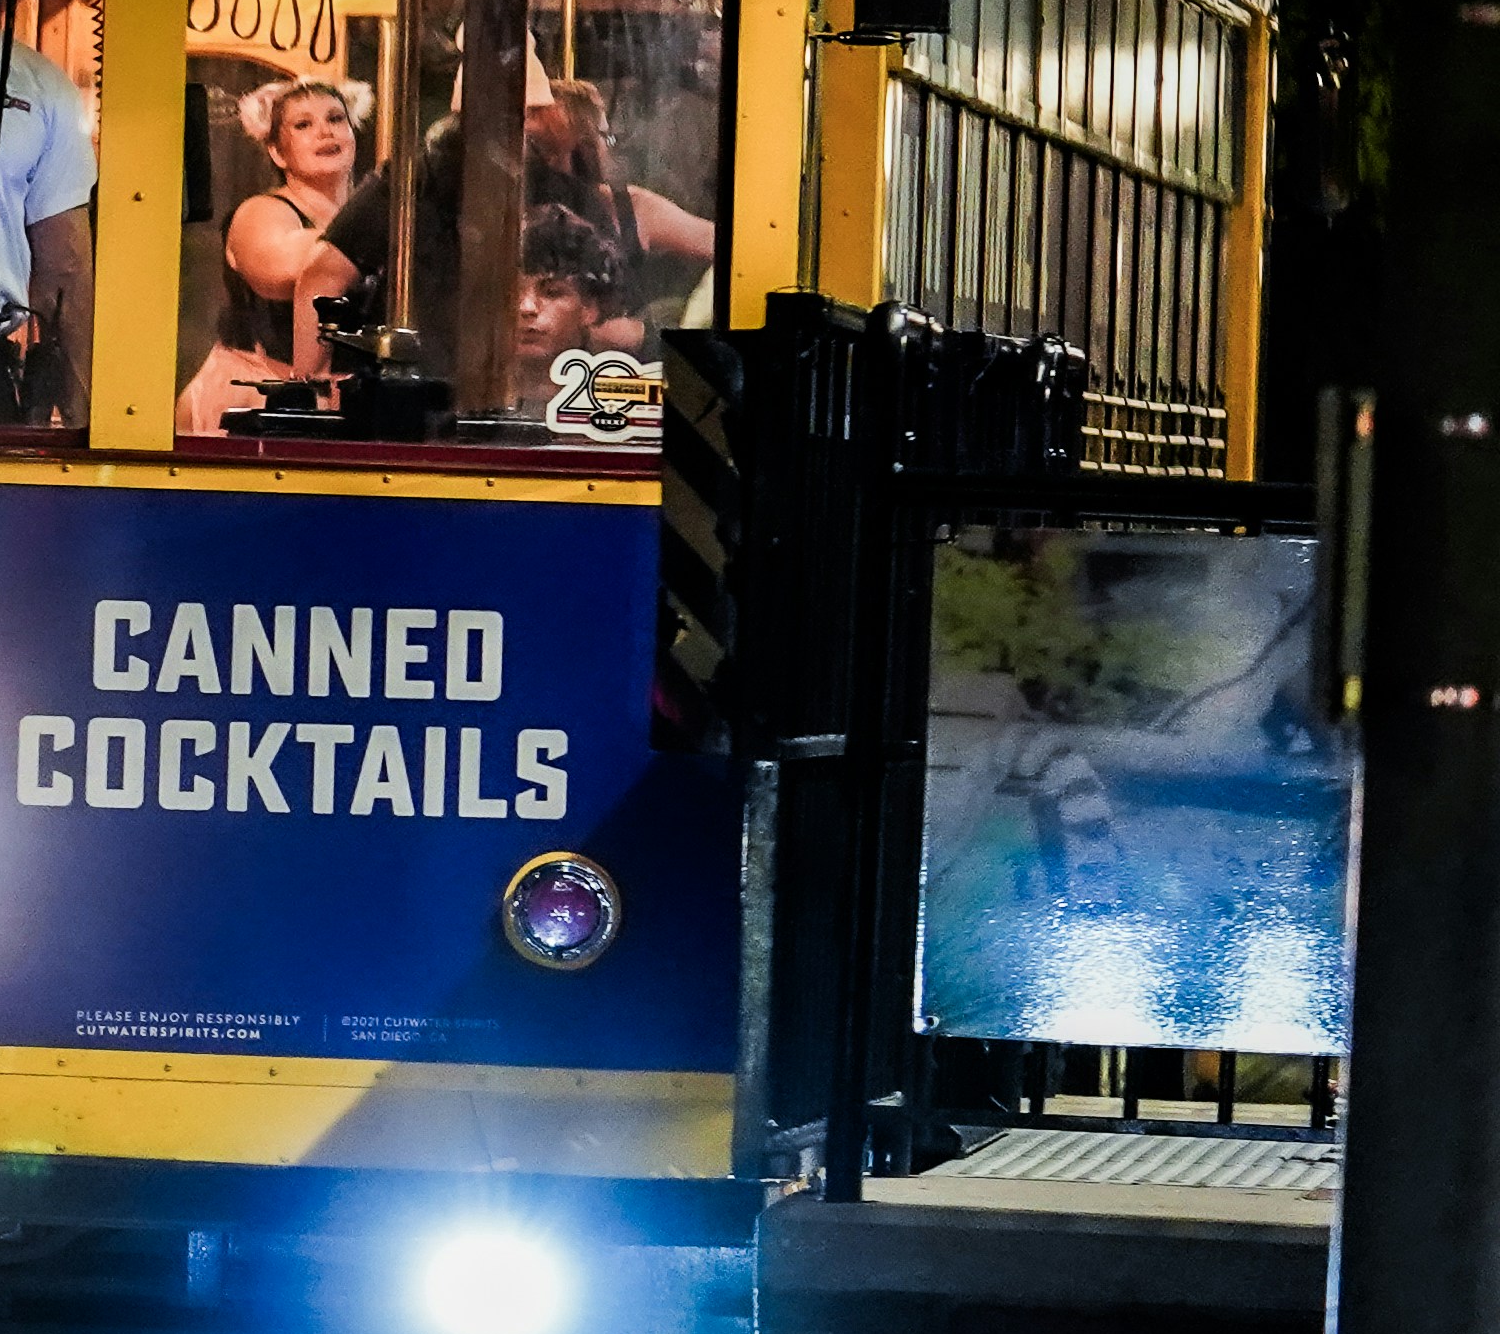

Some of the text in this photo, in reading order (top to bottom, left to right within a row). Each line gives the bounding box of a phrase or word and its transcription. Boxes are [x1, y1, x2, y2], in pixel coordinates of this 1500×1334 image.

[92, 598, 504, 702] CANNED
[16, 714, 569, 821] COCKTAILS
[76, 1010, 301, 1026] PLEASE ENJOY RESPONSIBLY
[76, 1025, 261, 1040] CUTWATERSPIRITS.COM
[350, 1030, 377, 1042] SAN
